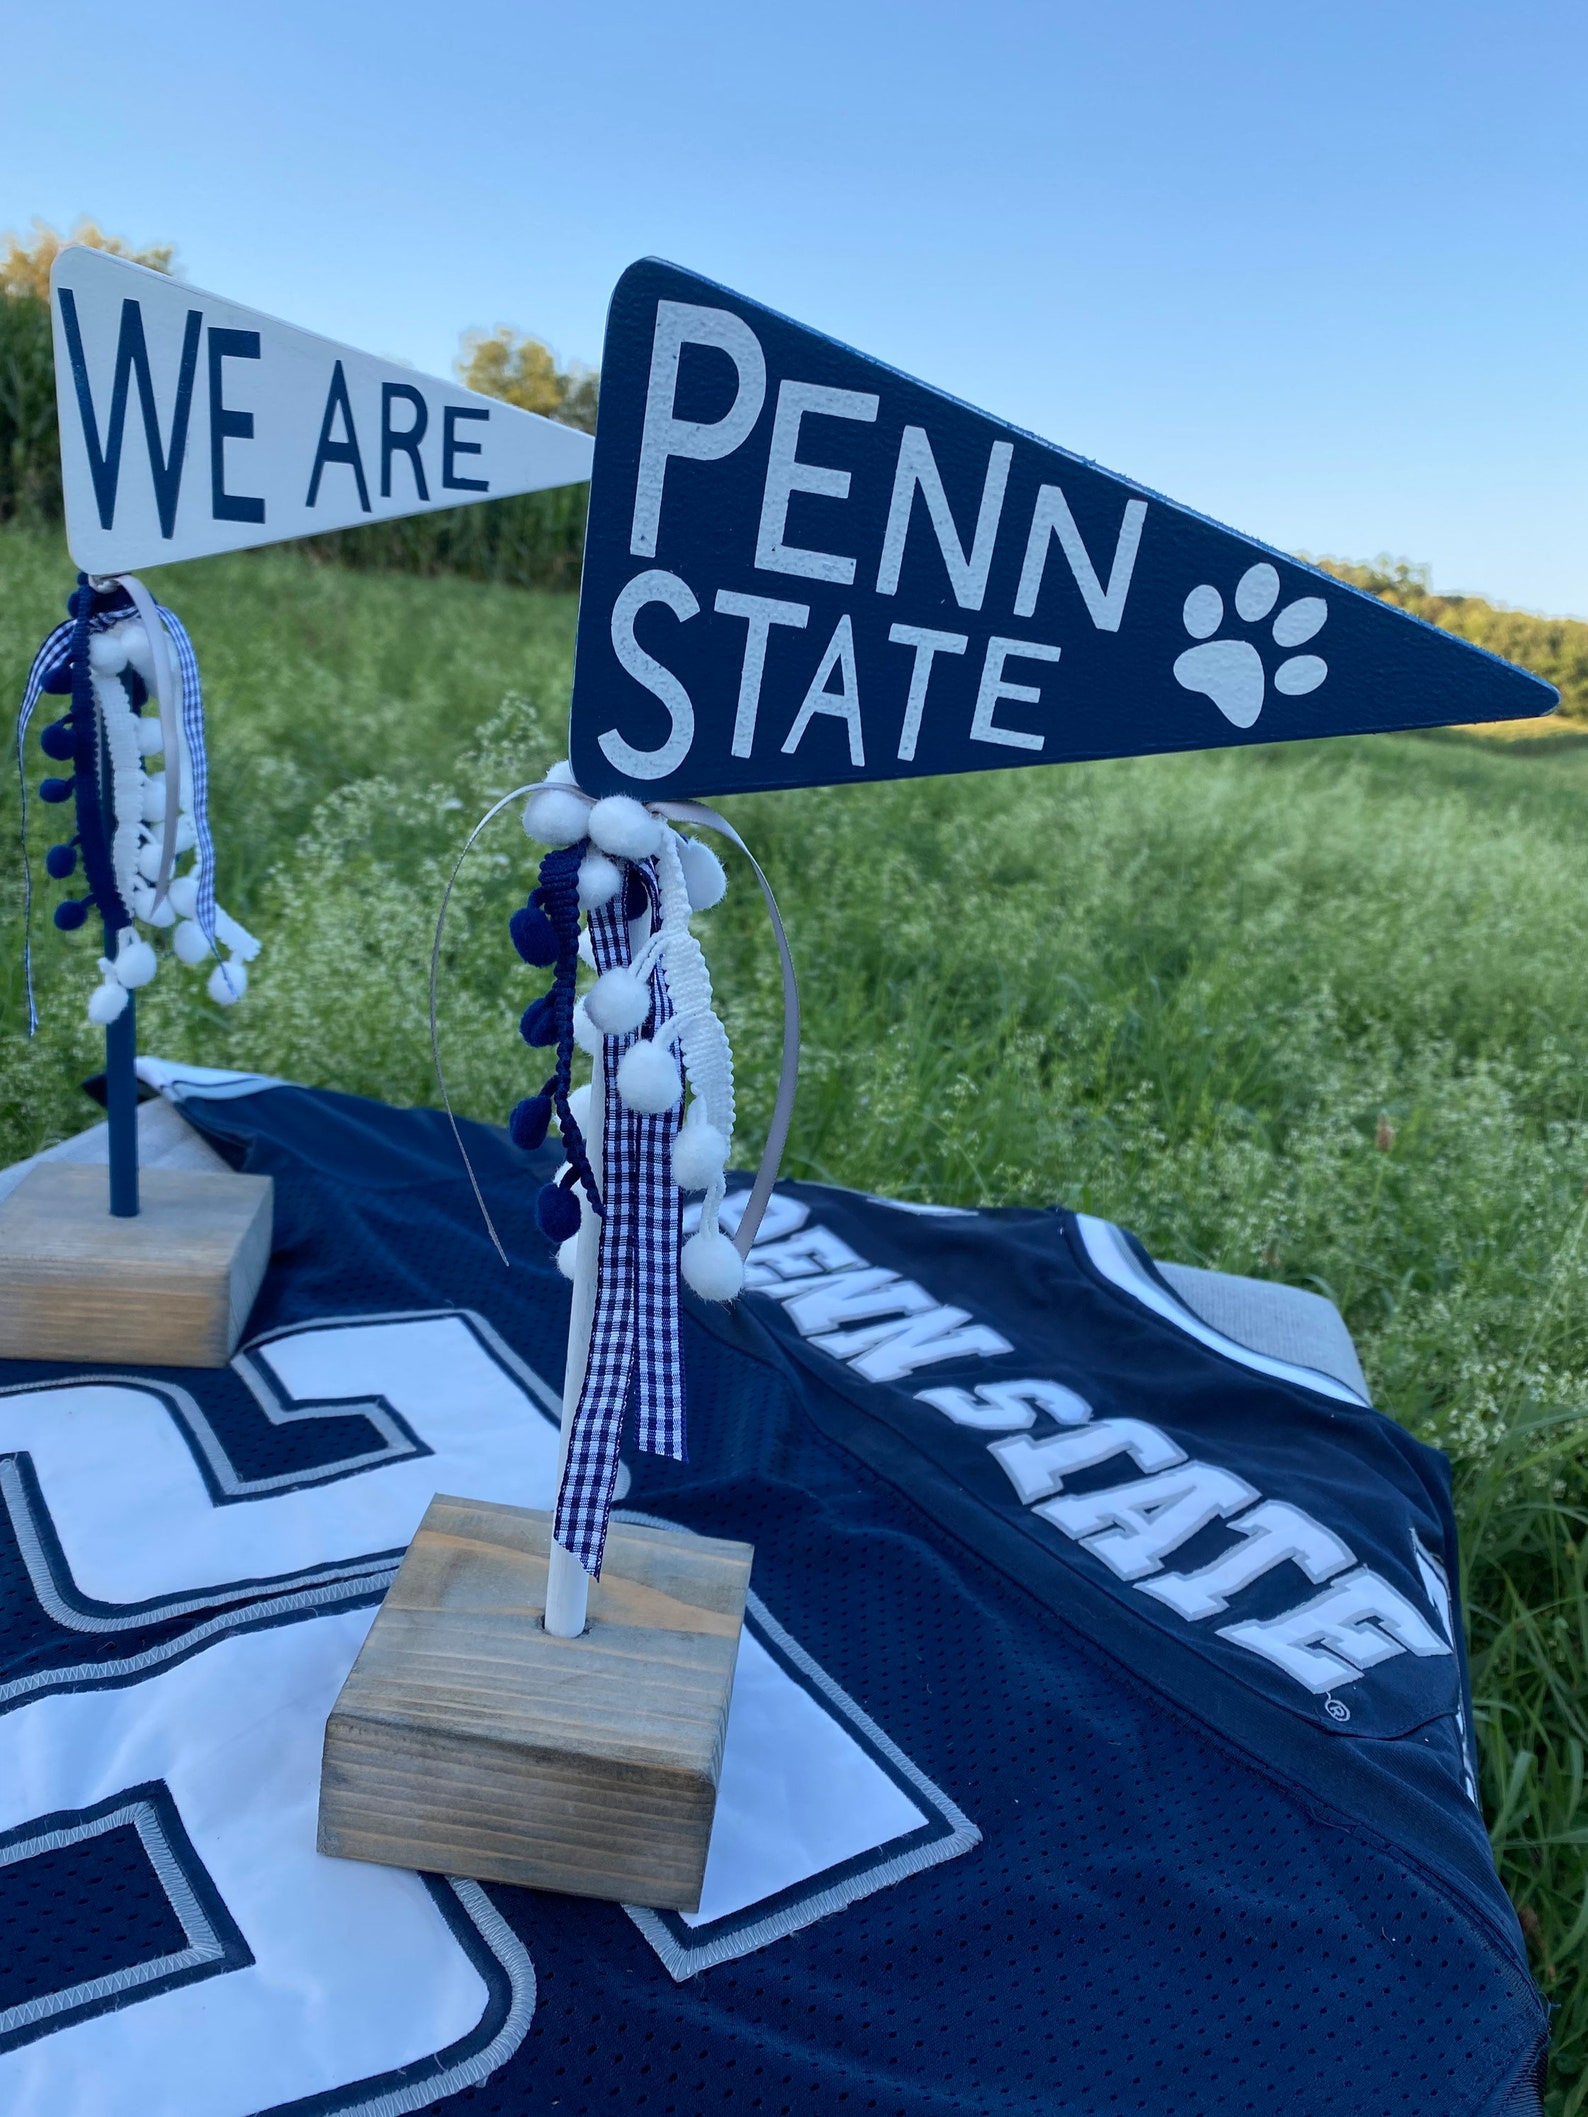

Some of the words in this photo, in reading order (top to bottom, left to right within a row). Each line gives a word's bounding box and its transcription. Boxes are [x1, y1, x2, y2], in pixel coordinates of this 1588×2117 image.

[58, 288, 265, 539] WE
[305, 360, 489, 512] ARE
[630, 299, 1147, 632] PENN
[598, 569, 1060, 779] STATE
[912, 1379, 1454, 1694] STATE
